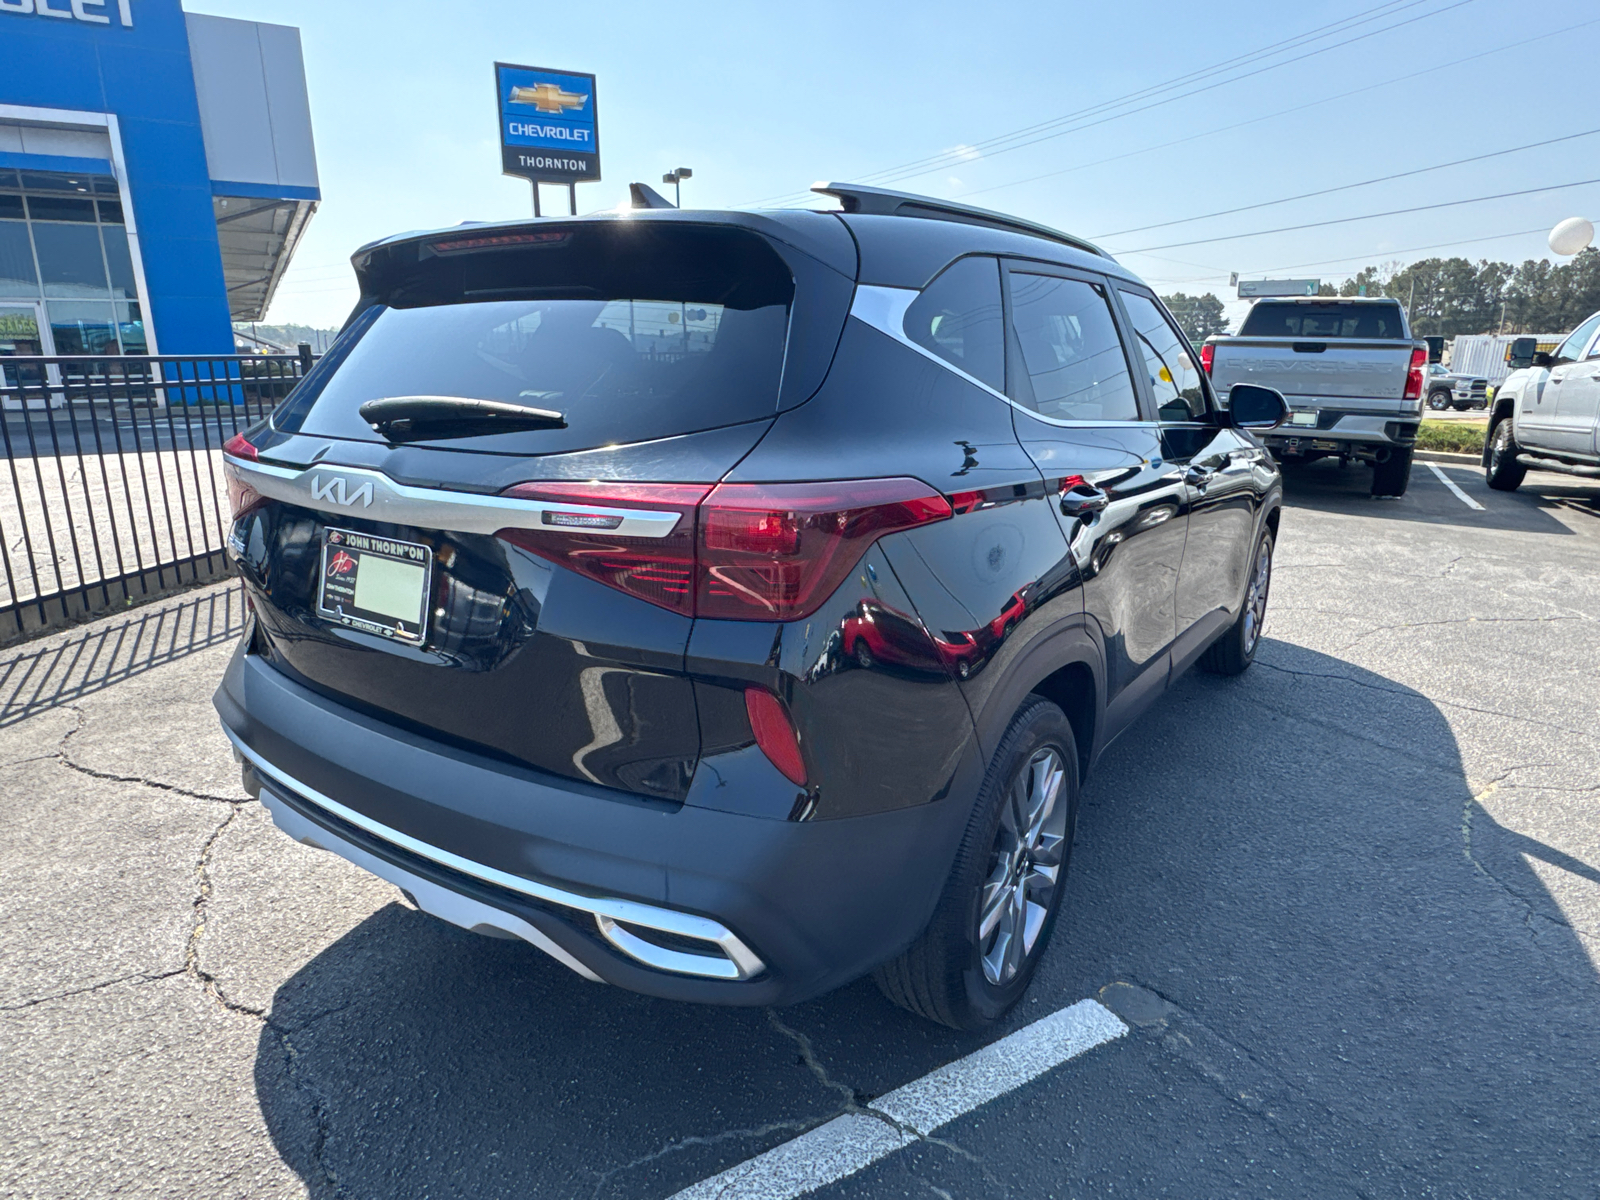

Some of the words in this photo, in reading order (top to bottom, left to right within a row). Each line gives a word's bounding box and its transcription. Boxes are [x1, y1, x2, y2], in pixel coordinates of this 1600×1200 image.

[509, 123, 590, 141] CHEVROLET
[519, 155, 586, 171] THORNTON
[311, 474, 374, 508] KIA
[345, 534, 370, 549] JOHN
[371, 540, 424, 560] THORNTON
[351, 620, 382, 634] CHEVROLET
